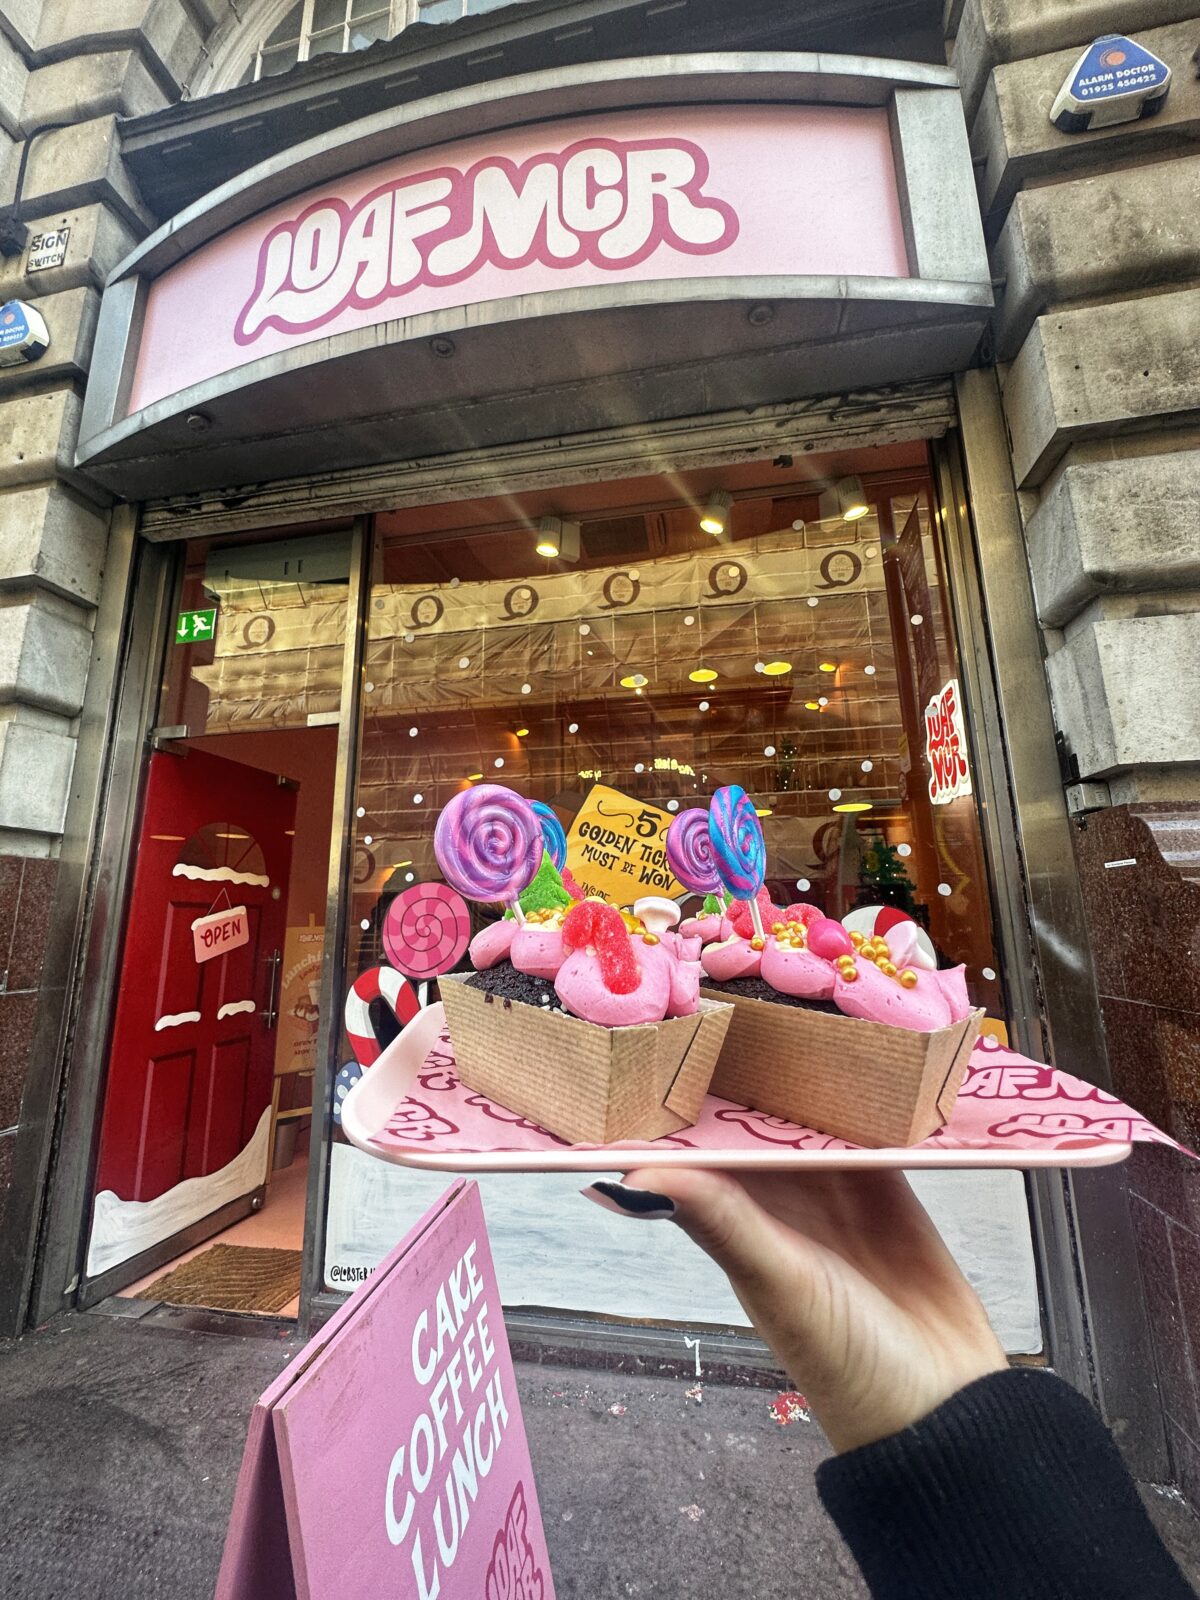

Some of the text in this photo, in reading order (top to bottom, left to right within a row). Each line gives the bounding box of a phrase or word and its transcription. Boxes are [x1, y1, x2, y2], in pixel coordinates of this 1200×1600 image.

[1078, 63, 1156, 87] ALARM DOCTOR
[1081, 73, 1157, 96] 01925 450422
[28, 252, 64, 267] SWITCH
[31, 232, 67, 252] SIGN
[237, 141, 736, 344] LOAF MCR
[635, 809, 662, 838] 5
[578, 821, 671, 873] GOLDEN TICK
[581, 844, 677, 891] MUST BE WON
[200, 918, 242, 948] OPEN
[411, 1239, 484, 1385] CAKE
[384, 1301, 496, 1546] COFFEE
[410, 1366, 510, 1600] LUNCH
